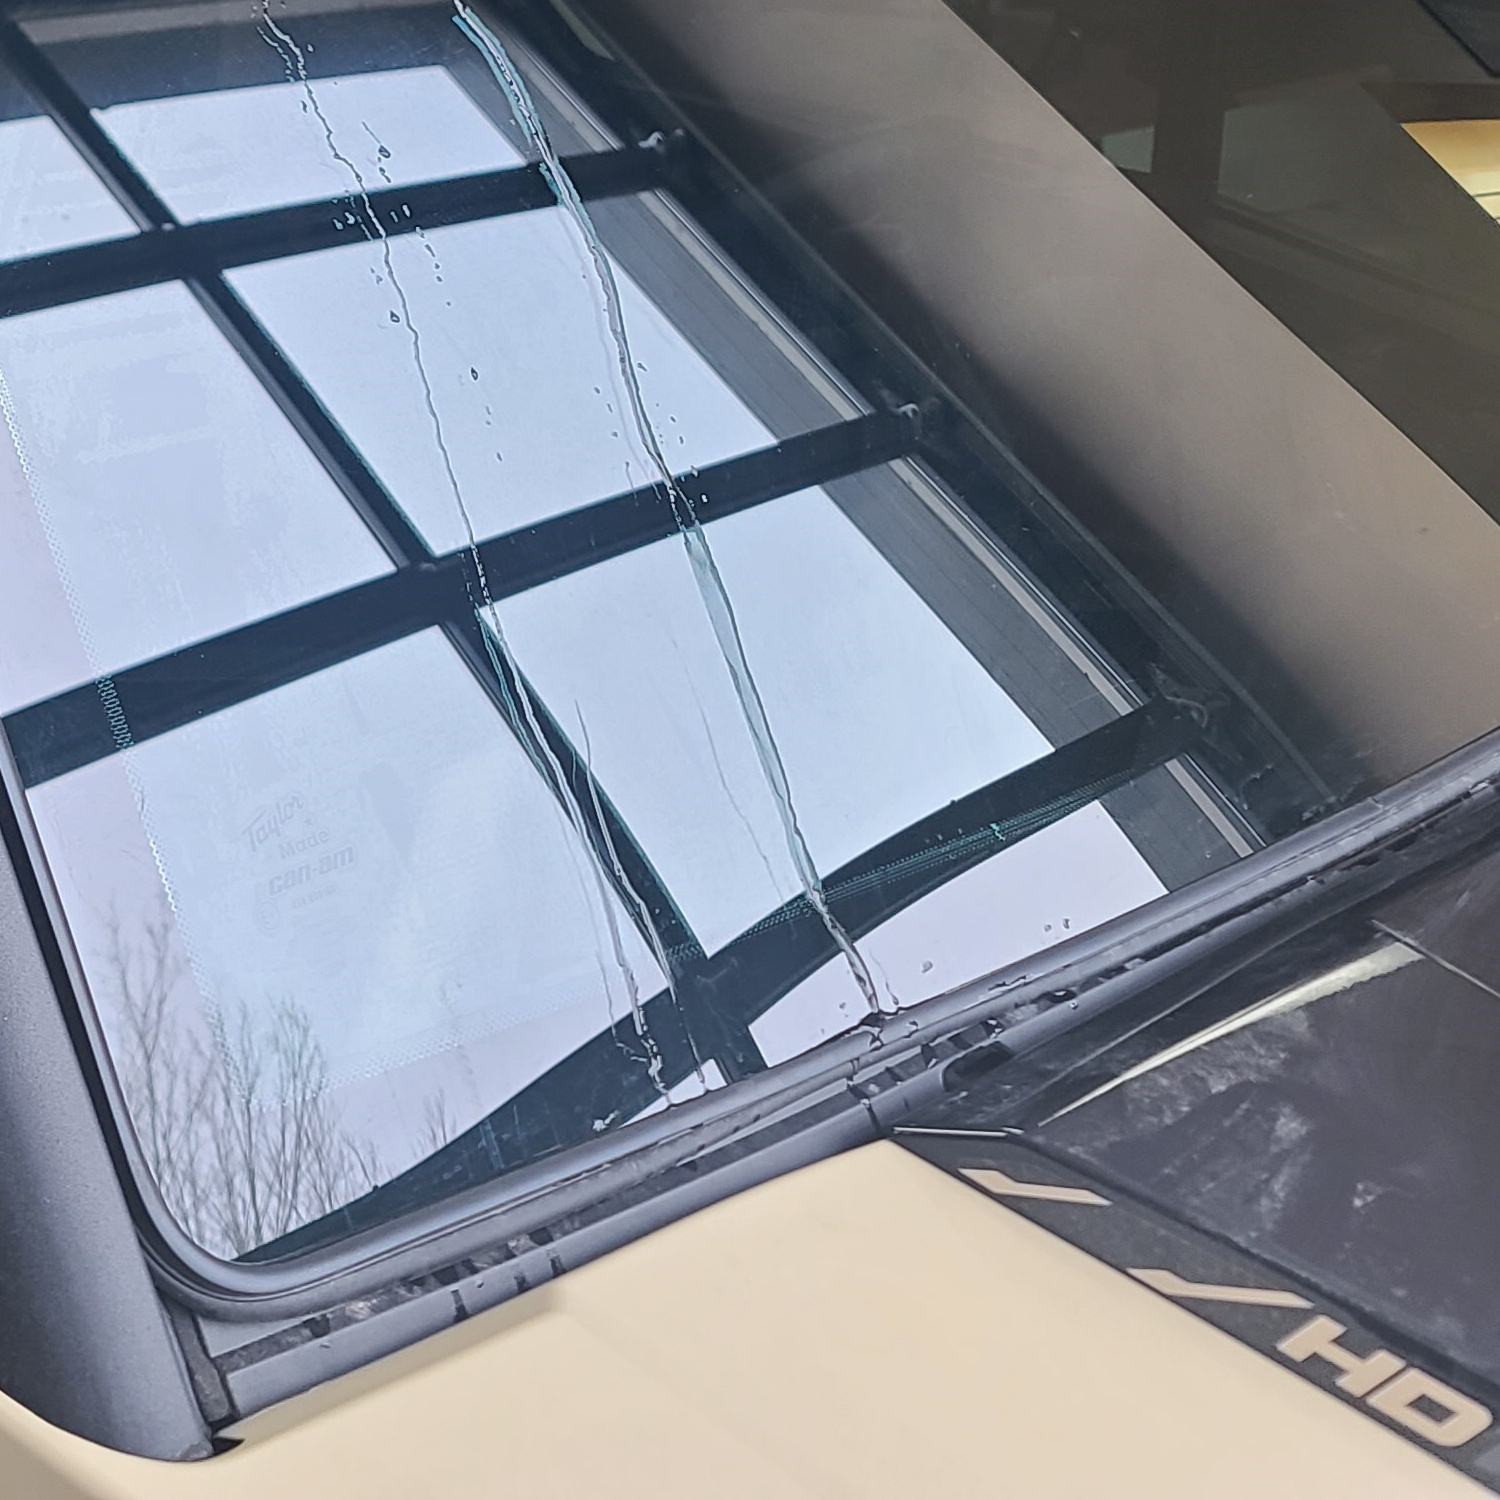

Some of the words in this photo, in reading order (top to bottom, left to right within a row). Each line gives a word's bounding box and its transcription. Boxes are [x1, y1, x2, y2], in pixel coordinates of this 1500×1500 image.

[241, 794, 304, 853] Taylor
[278, 829, 330, 860] Made
[268, 846, 354, 896] can-am
[1277, 1314, 1493, 1446] HD
